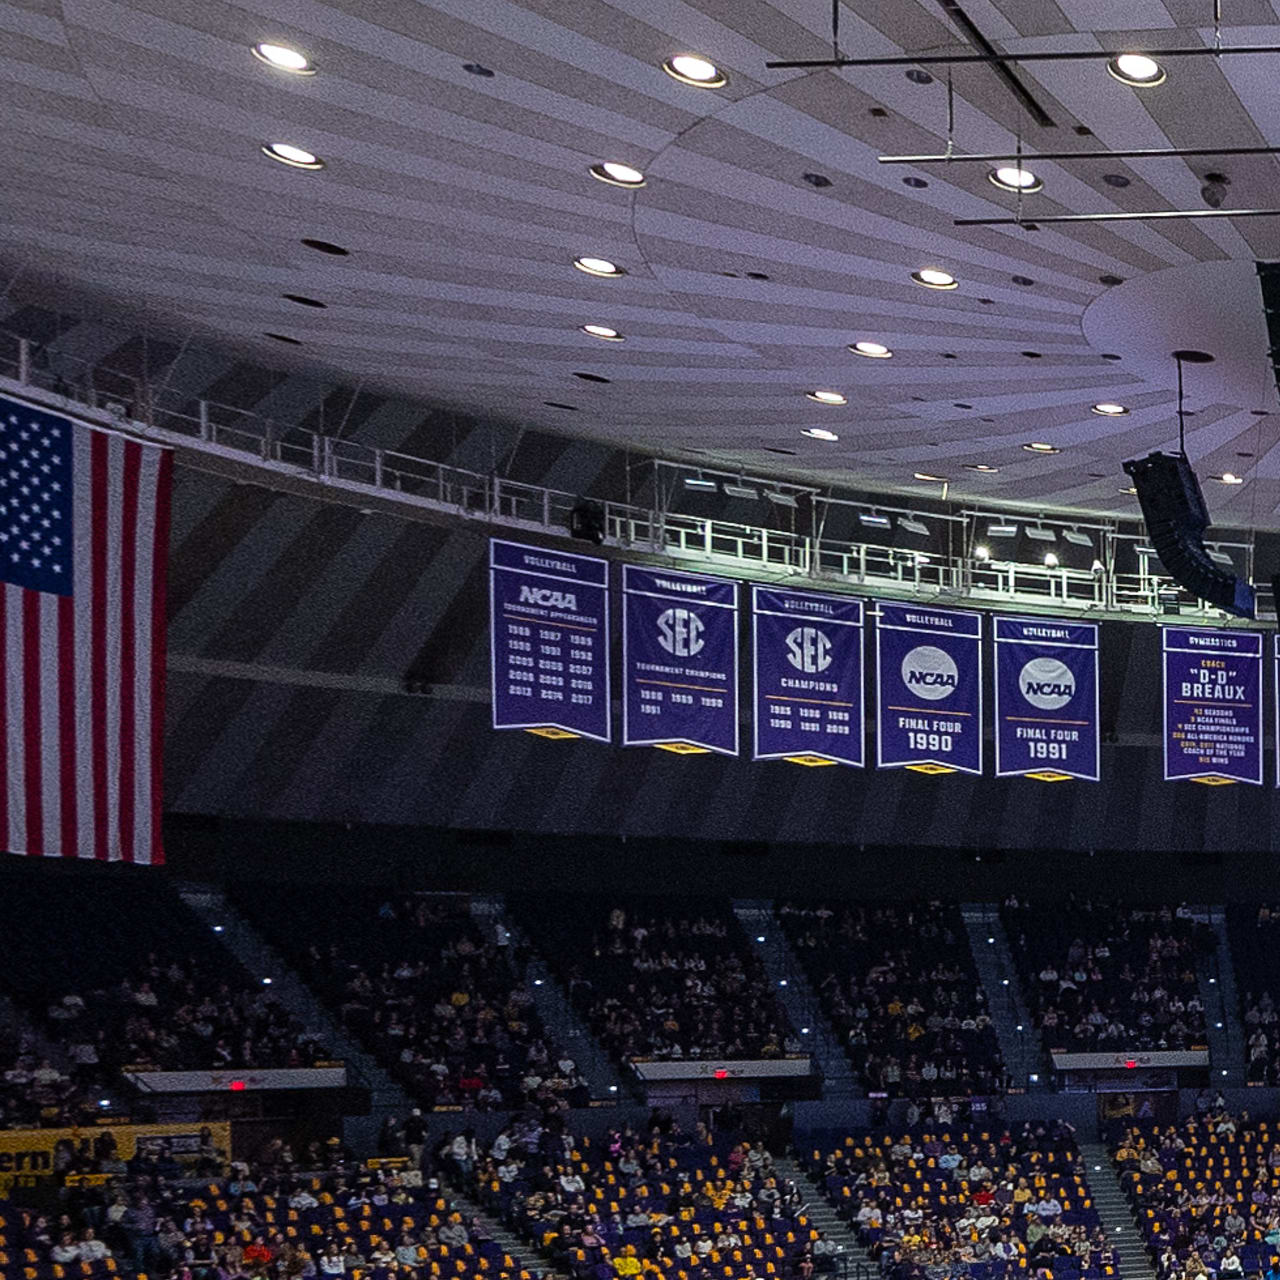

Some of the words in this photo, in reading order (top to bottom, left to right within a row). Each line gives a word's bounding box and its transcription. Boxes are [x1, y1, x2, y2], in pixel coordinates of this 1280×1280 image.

[520, 586, 578, 610] NCAA
[657, 608, 705, 656] SEC
[785, 627, 833, 673] SEC
[781, 678, 838, 692] CHAMPIONS
[908, 670, 956, 688] NCAA
[1025, 681, 1073, 697] NCAA
[1182, 682, 1245, 700] BREAUX
[899, 717, 930, 731] FINAL
[933, 720, 962, 733] FOUR
[1016, 727, 1048, 740] FINAL
[1050, 728, 1079, 741] FOUR
[908, 732, 952, 751] 1990
[1028, 741, 1067, 760] 1991
